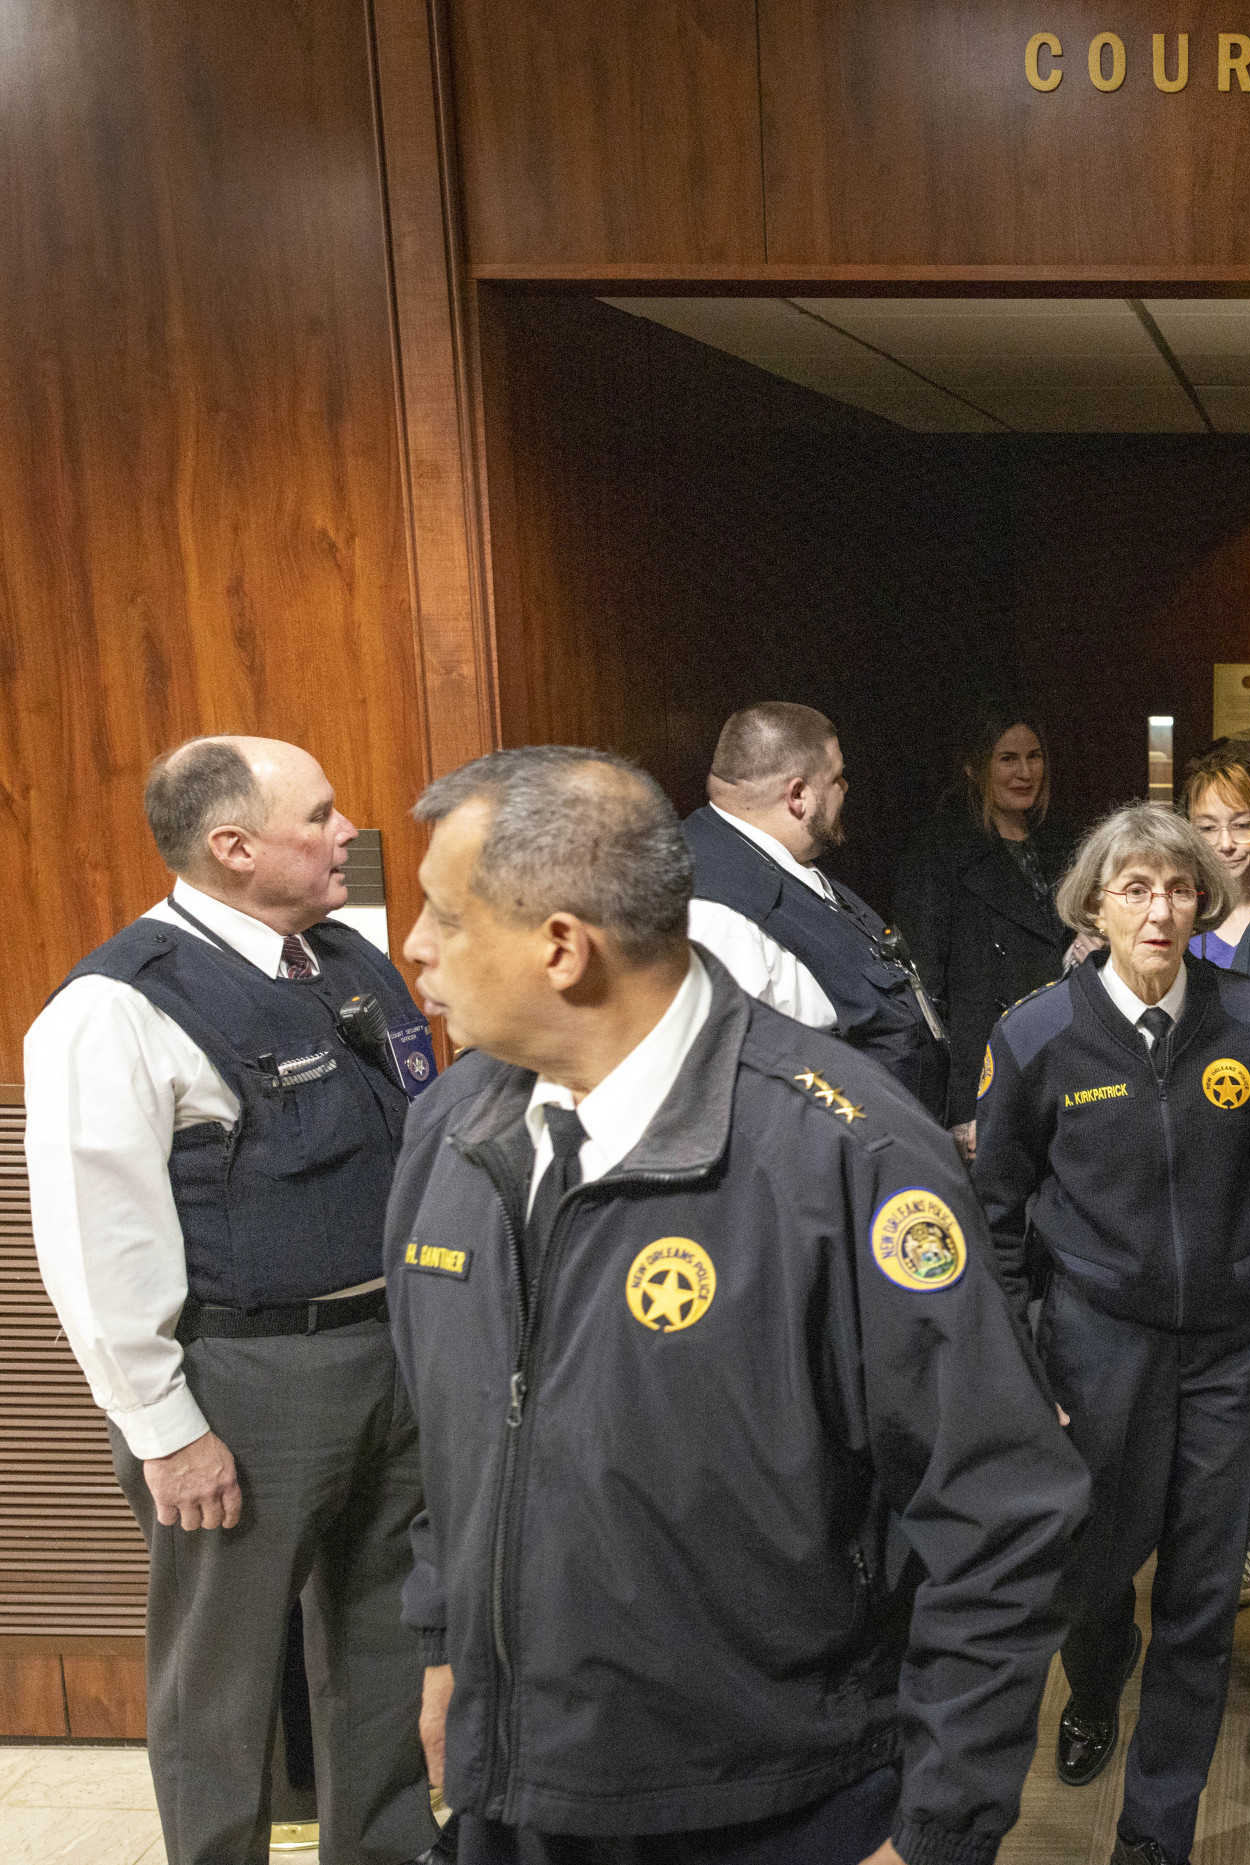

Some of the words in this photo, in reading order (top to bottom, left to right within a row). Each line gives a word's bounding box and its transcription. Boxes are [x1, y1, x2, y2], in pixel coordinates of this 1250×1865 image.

[1064, 1094, 1074, 1107] A.
[1074, 1083, 1128, 1105] KIRKPATRICK
[883, 1199, 926, 1234] ORLEANS
[880, 1234, 898, 1260] NEW
[631, 1262, 647, 1289] NEW
[646, 1247, 695, 1266] ORLEANS
[693, 1261, 710, 1301] POLICE
